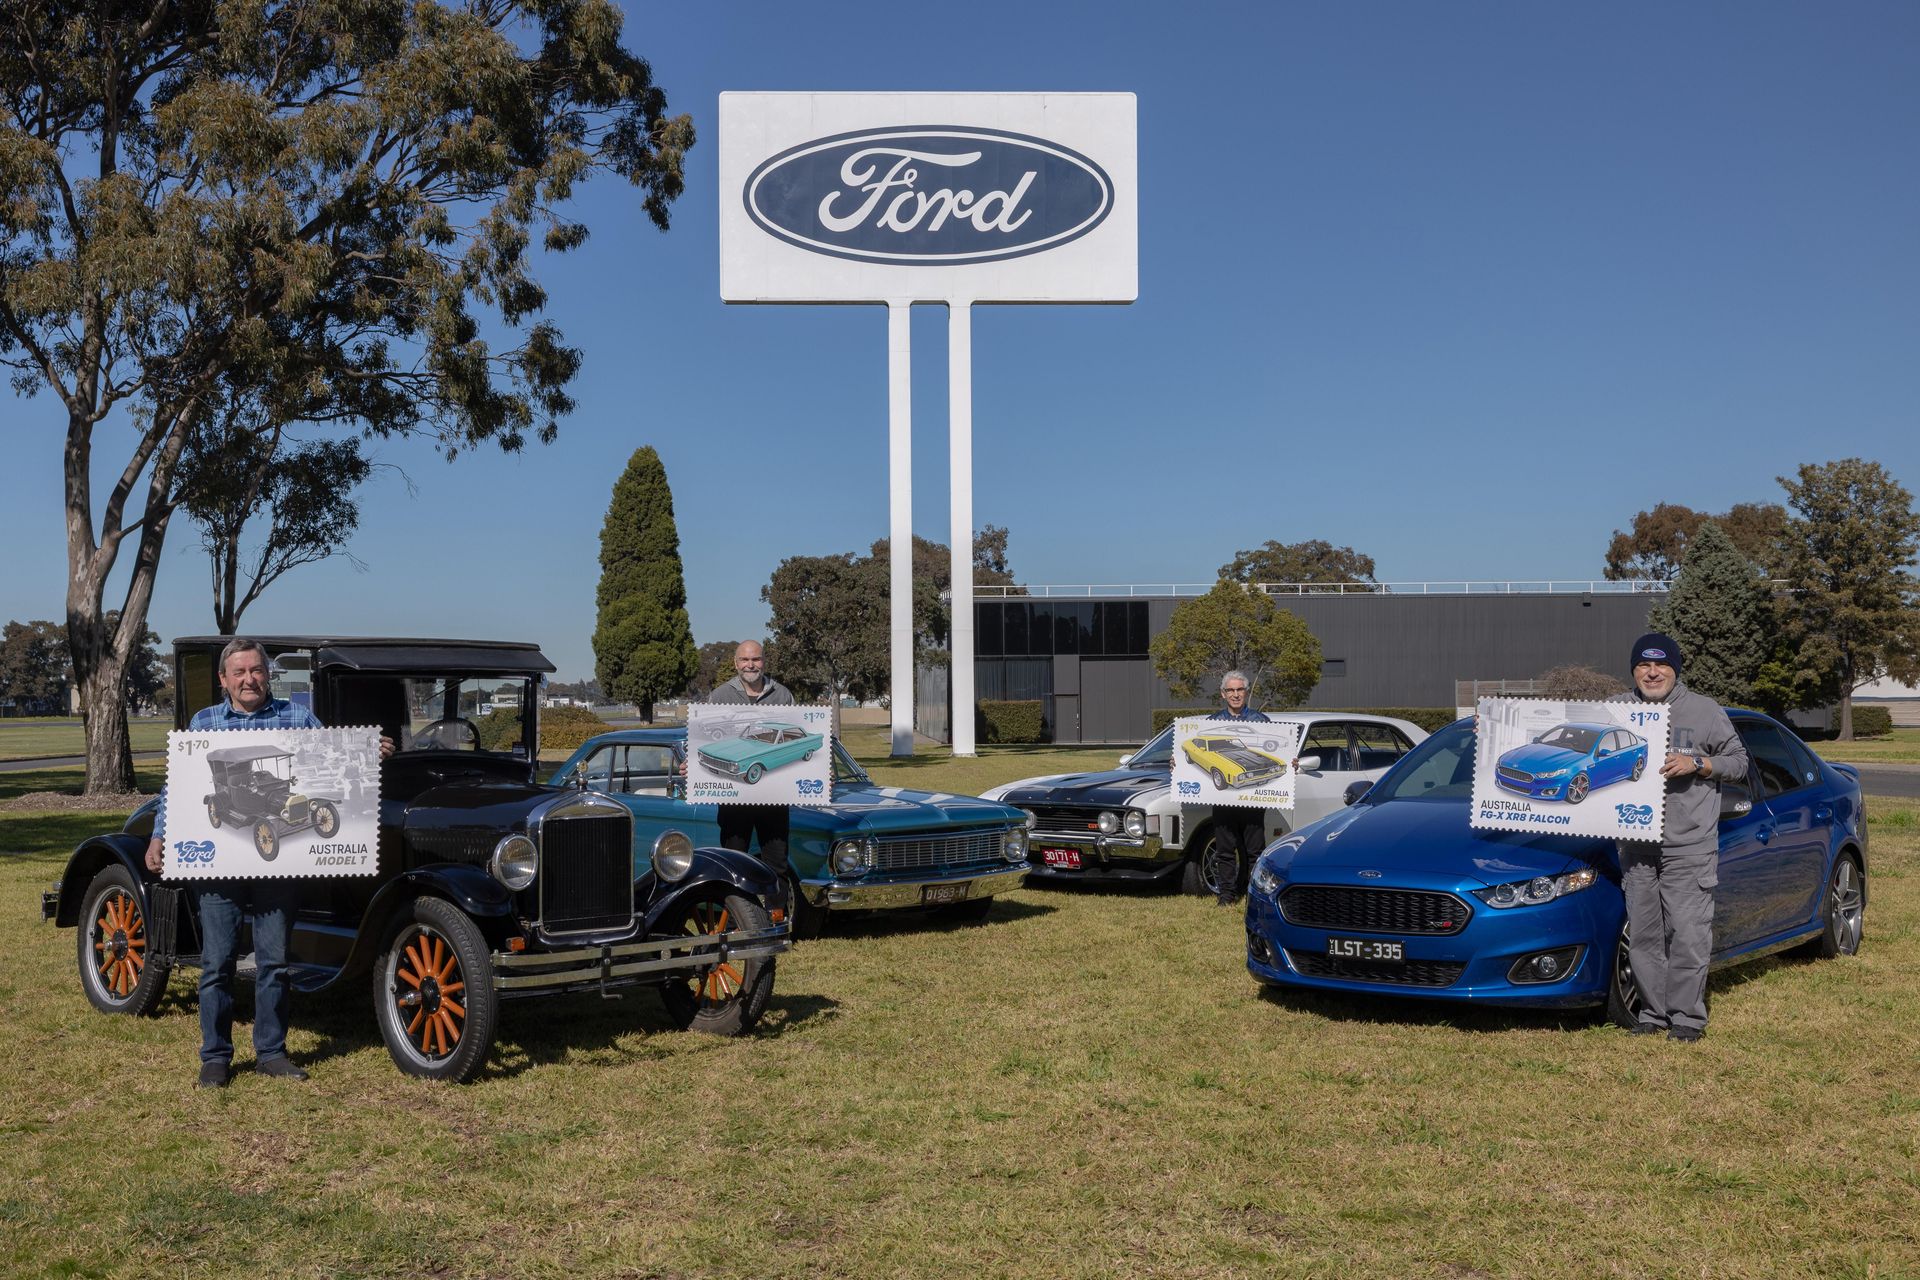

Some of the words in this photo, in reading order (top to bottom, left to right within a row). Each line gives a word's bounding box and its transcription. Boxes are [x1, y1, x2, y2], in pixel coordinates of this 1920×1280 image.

[818, 147, 1037, 232] Ford
[1630, 712, 1660, 726] $1.70
[178, 740, 209, 755] $1.70
[693, 782, 734, 790] AUSTRALIA
[1254, 789, 1289, 797] AUSTRALIA
[1480, 800, 1531, 812] AUSTRALIA
[1480, 811, 1503, 820] FG-X
[1505, 812, 1526, 822] XR8
[1529, 814, 1570, 825] FALCON
[1619, 804, 1653, 823] Ford
[178, 842, 216, 861] Ford
[309, 844, 368, 855] AUSTRALIA
[315, 856, 356, 866] MODEL
[360, 856, 368, 865] T
